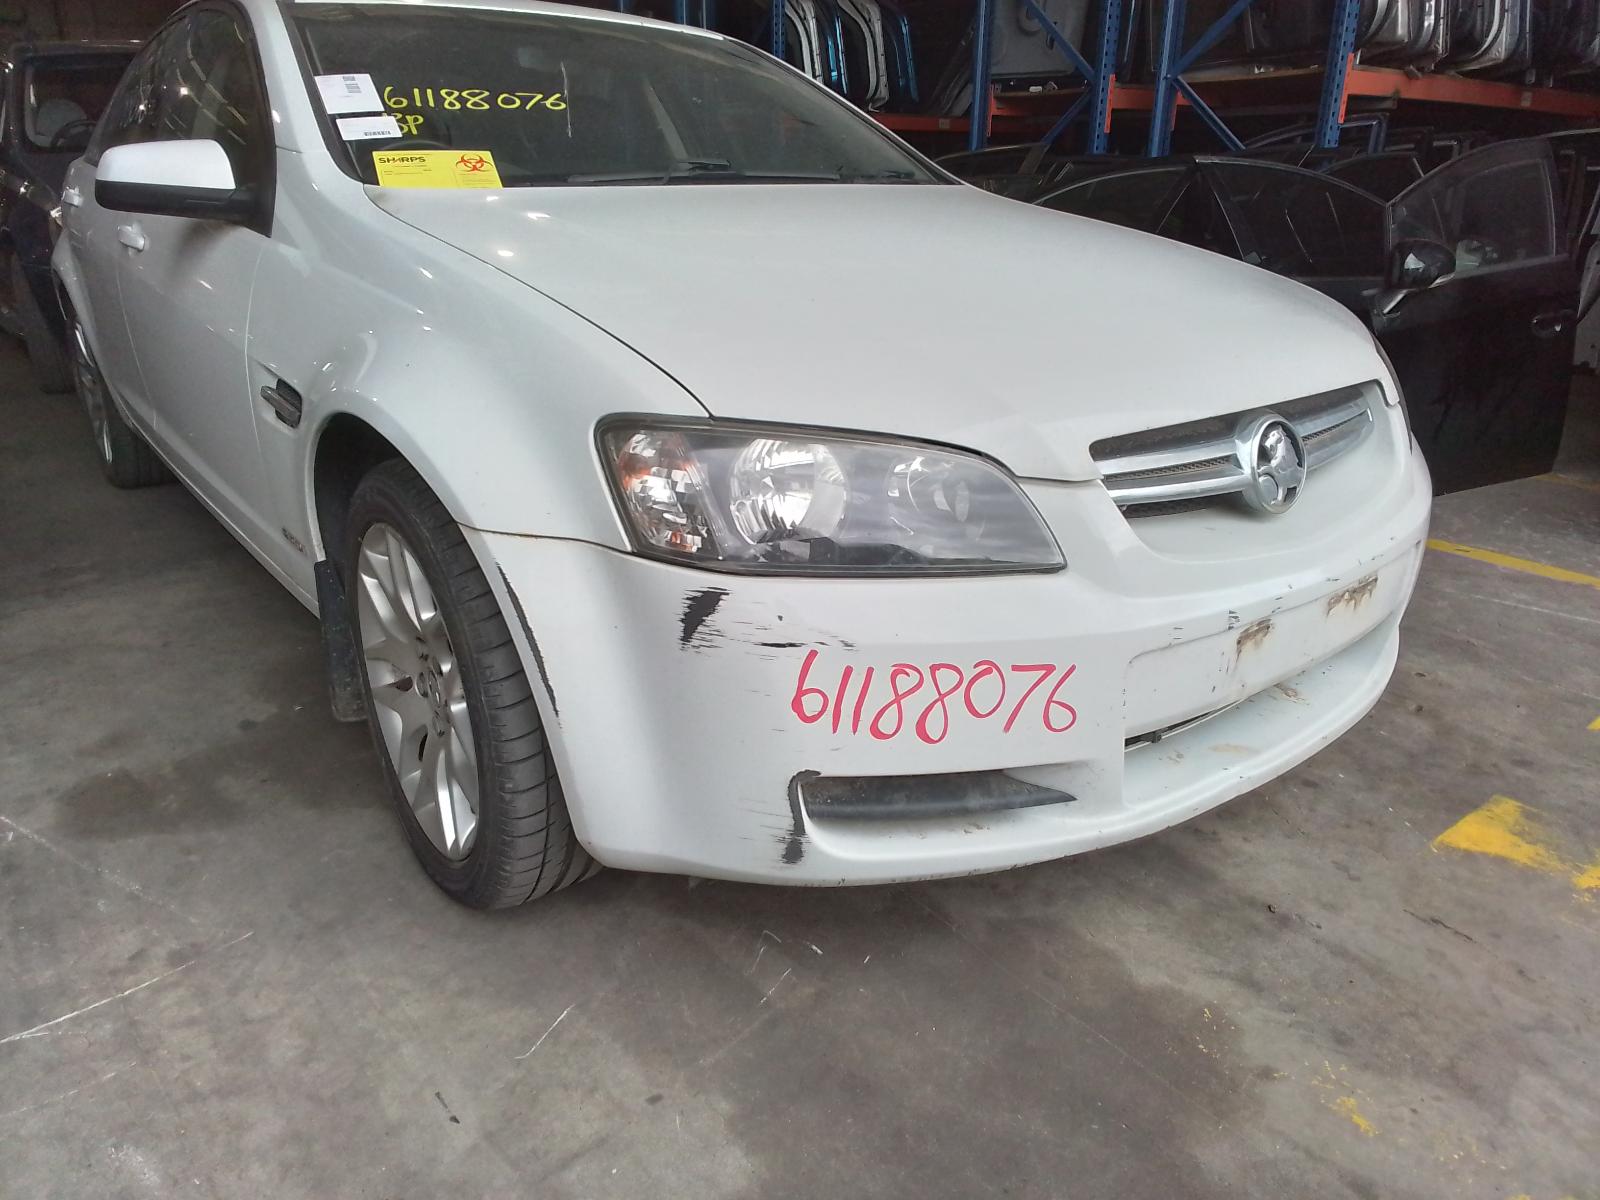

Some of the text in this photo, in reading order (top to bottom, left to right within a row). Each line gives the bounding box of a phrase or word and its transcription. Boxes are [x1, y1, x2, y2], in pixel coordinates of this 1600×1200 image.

[383, 86, 567, 111] 61188076
[378, 156, 426, 164] SHARPS
[791, 648, 1077, 745] 61188076
